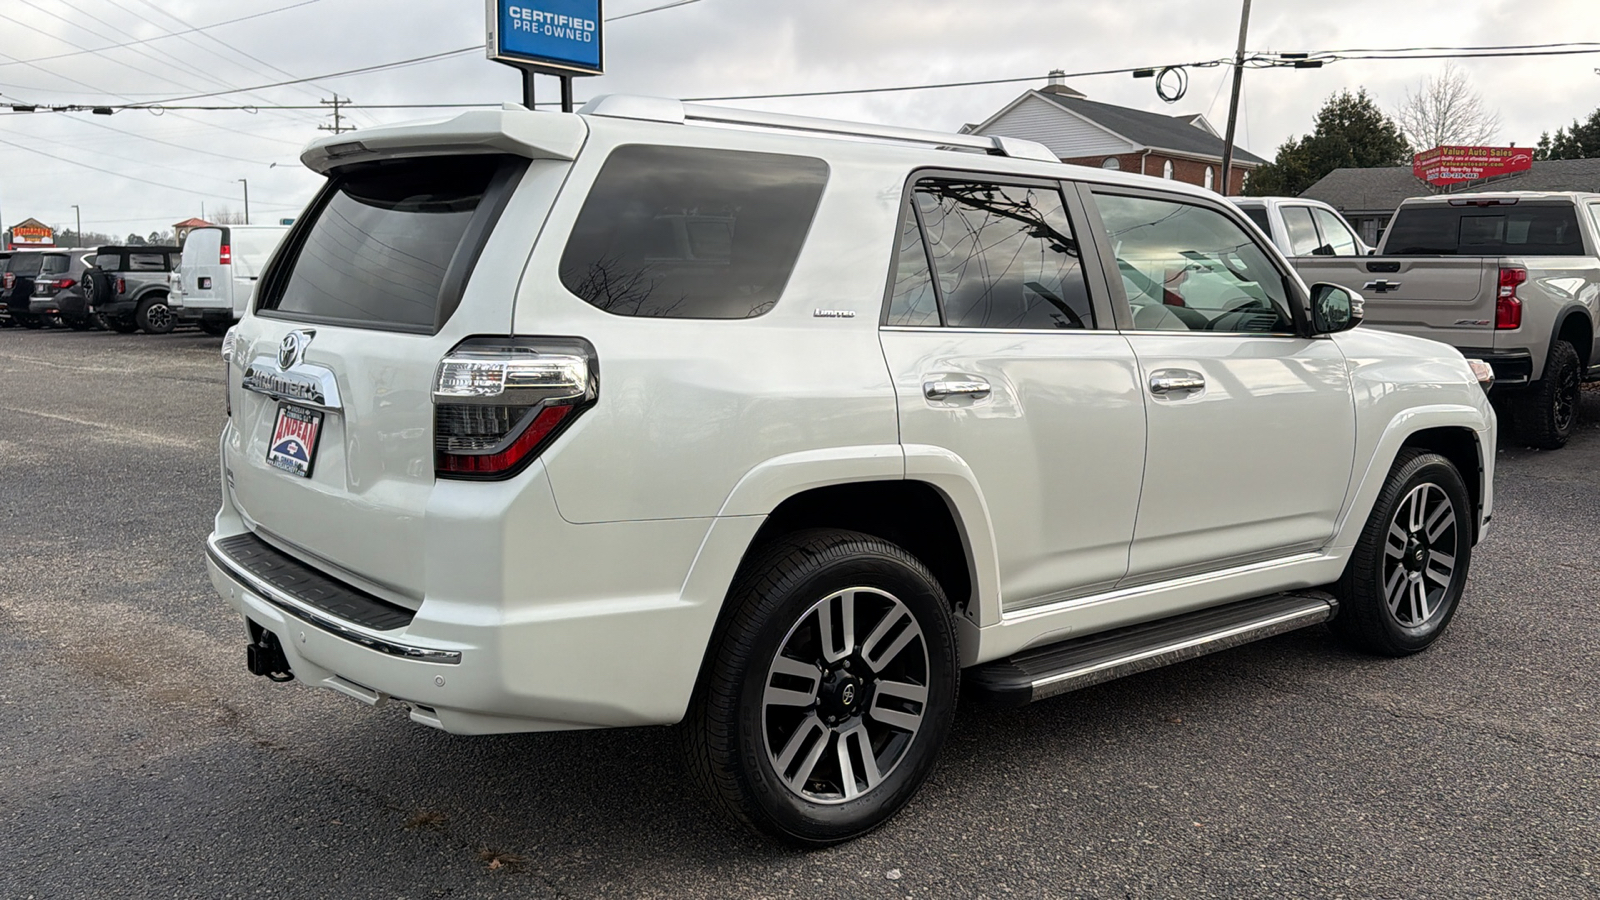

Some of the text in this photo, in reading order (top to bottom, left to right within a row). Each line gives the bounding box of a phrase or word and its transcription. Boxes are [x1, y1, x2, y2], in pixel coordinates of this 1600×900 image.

[509, 6, 595, 31] CERTIFIED
[514, 19, 592, 42] PRE-OWNED
[1443, 147, 1465, 155] Value
[1468, 148, 1487, 156] Auto
[1490, 148, 1512, 157] Sales
[273, 414, 318, 457] ANDEAN
